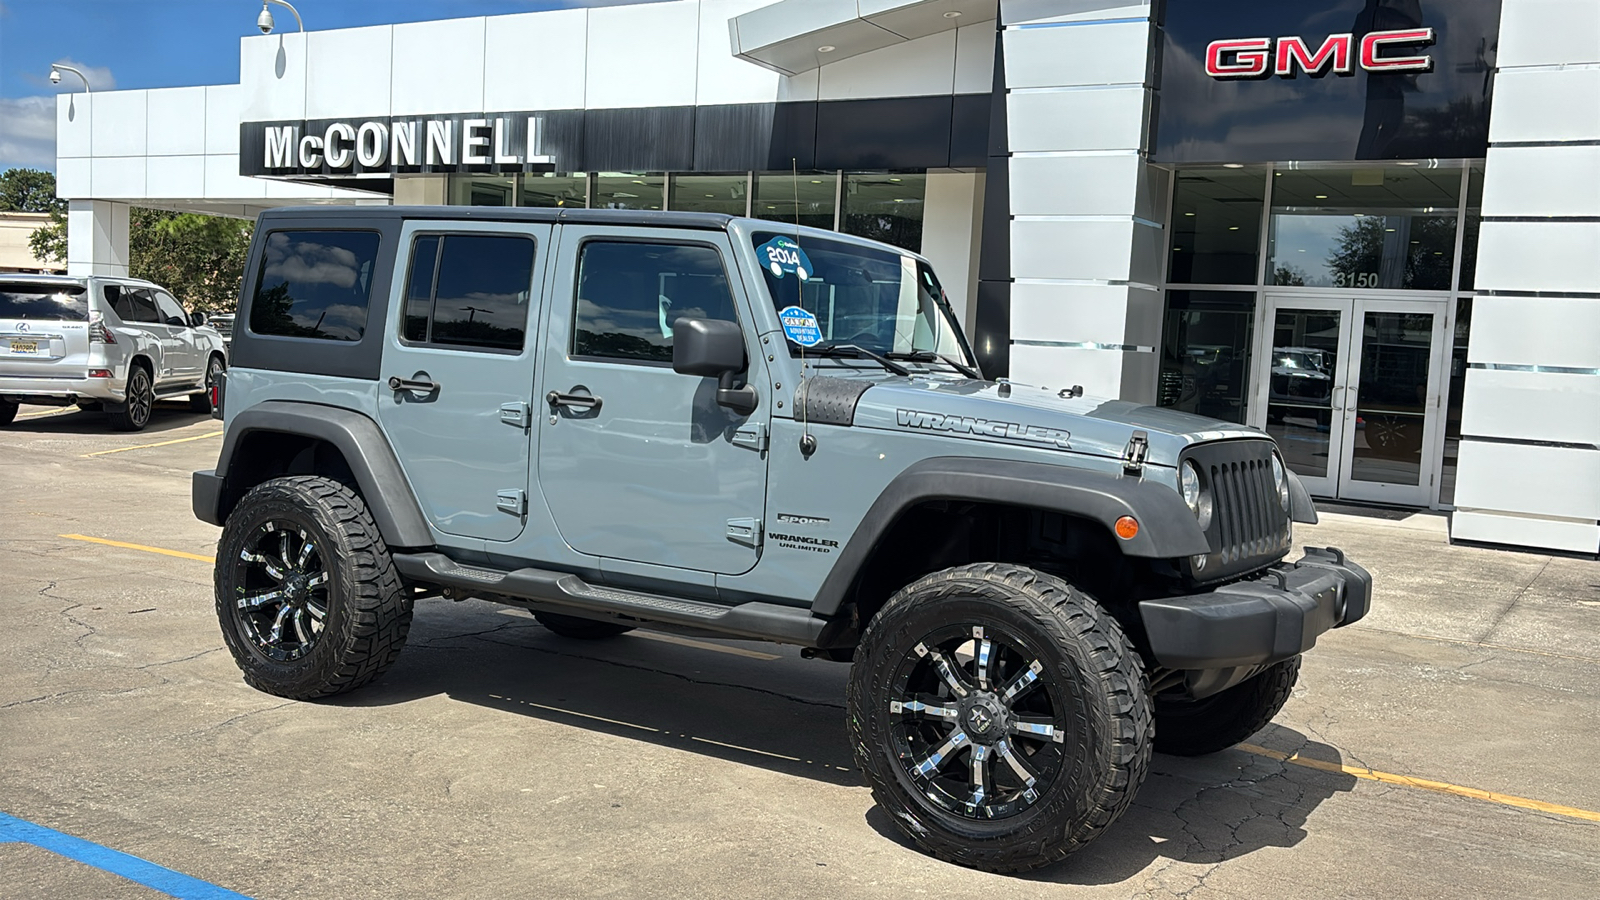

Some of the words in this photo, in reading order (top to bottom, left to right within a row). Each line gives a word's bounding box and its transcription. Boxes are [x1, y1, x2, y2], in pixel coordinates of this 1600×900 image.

[1205, 27, 1434, 77] GMC
[263, 116, 556, 169] McCONNELL
[766, 246, 801, 266] 2014
[1336, 272, 1379, 288] 3150
[790, 327, 817, 336] ADVANTAGE
[796, 334, 816, 342] DEALER
[896, 408, 1072, 449] WRANGLER
[777, 514, 830, 526] SPORT
[768, 532, 839, 549] WRANGLER
[779, 542, 831, 554] UNLIMITED
